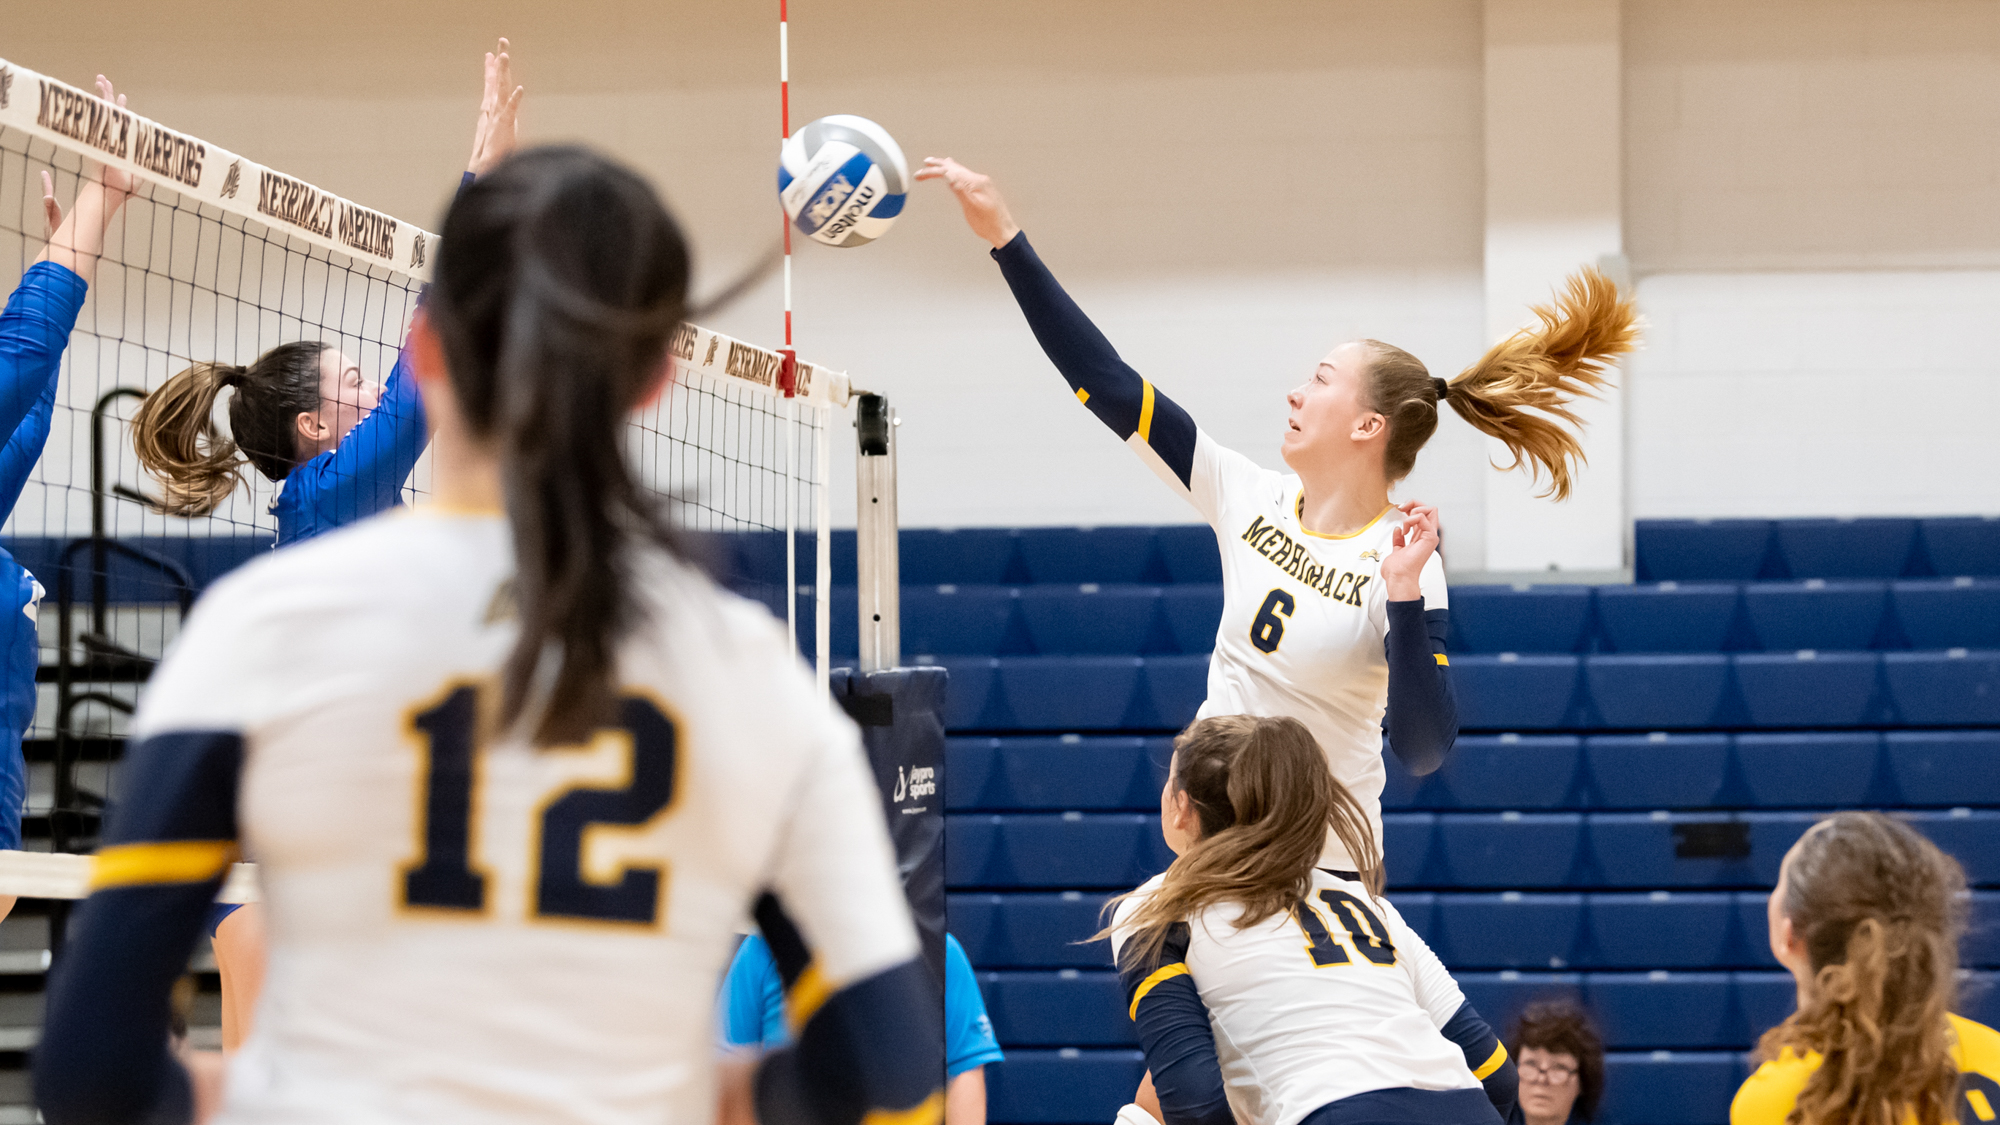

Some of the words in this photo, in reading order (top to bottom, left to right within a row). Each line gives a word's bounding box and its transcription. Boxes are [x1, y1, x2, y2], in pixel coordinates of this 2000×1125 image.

[37, 79, 131, 160] MERRIMACK
[134, 118, 205, 188] WARRIORS
[257, 170, 335, 239] MERRIMACK
[338, 201, 397, 260] WARRIORS
[821, 186, 875, 239] molten
[1241, 515, 1371, 607] MERRIMACK
[1250, 587, 1296, 656] 6
[396, 674, 687, 930] 12
[910, 781, 935, 800] sports
[1284, 888, 1397, 969] 10
